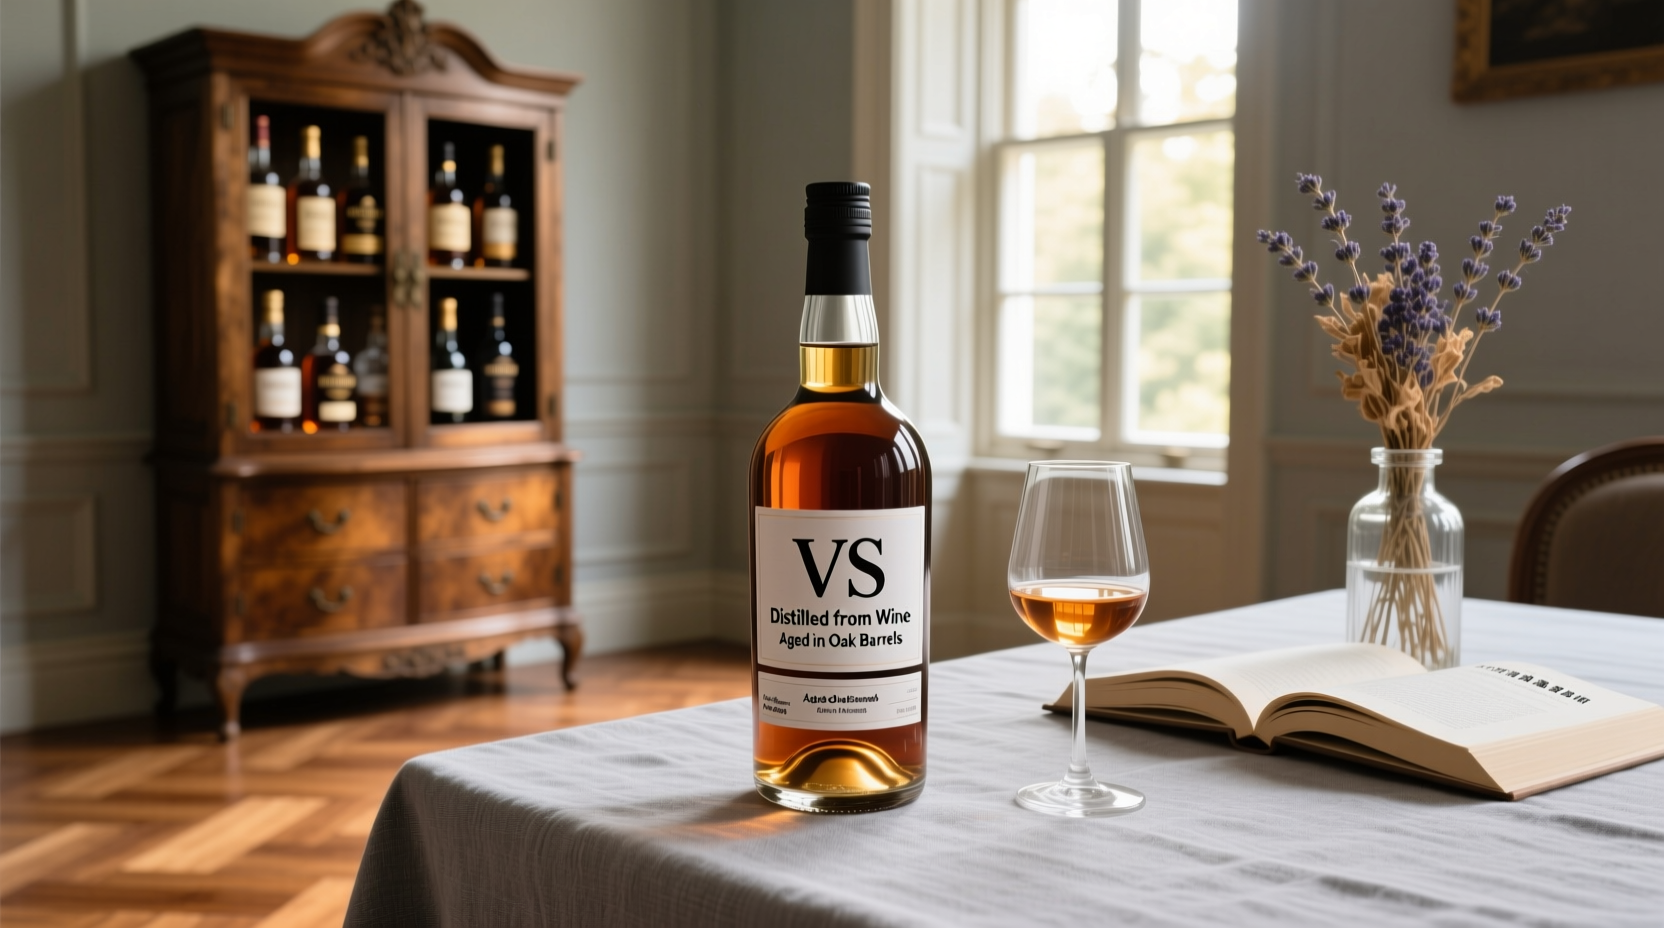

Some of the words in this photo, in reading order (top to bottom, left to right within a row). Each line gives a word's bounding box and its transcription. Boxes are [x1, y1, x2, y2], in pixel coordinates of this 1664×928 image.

[792, 537, 886, 598] VS
[770, 607, 829, 626] Distilled
[833, 609, 872, 626] from
[876, 608, 911, 625] Wine
[779, 632, 810, 650] Aged
[813, 633, 826, 648] in
[829, 633, 857, 648] Oak
[859, 631, 903, 647] Barrels
